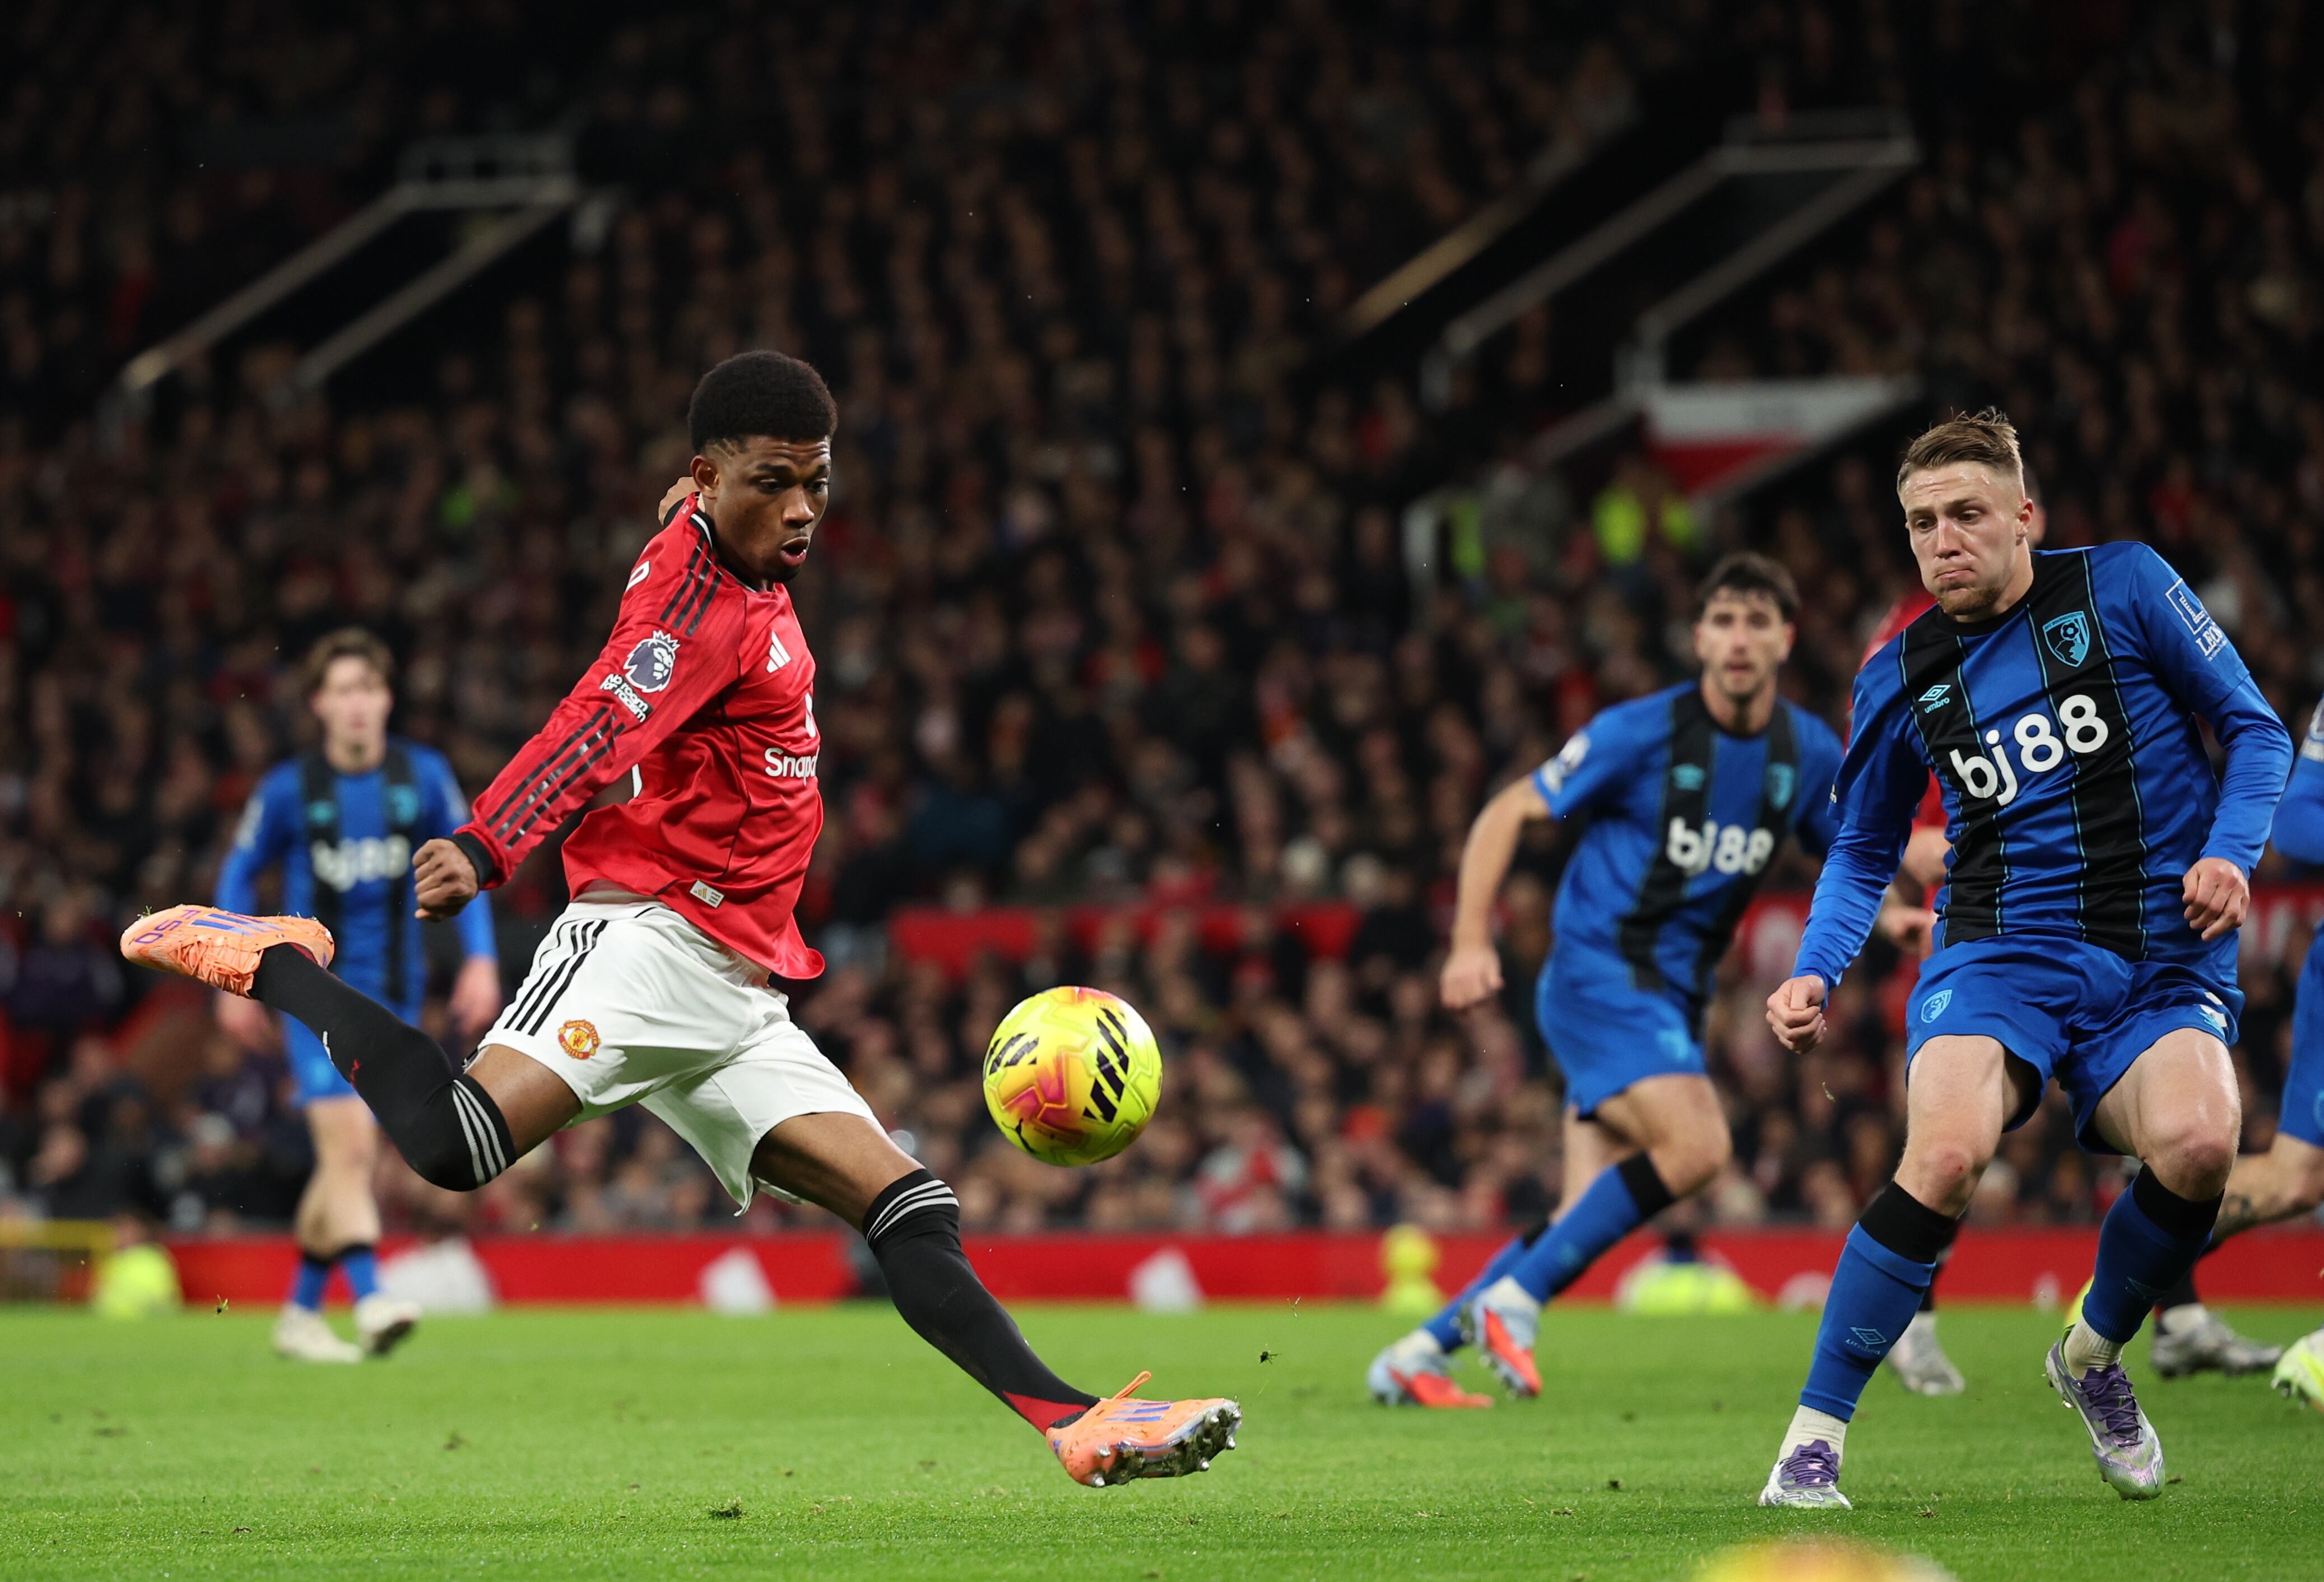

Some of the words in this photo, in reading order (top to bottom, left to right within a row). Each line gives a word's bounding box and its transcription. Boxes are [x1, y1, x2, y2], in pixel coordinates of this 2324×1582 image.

[620, 682, 648, 712] room
[1924, 697, 1950, 714] umbro
[1949, 694, 2108, 806] bj88
